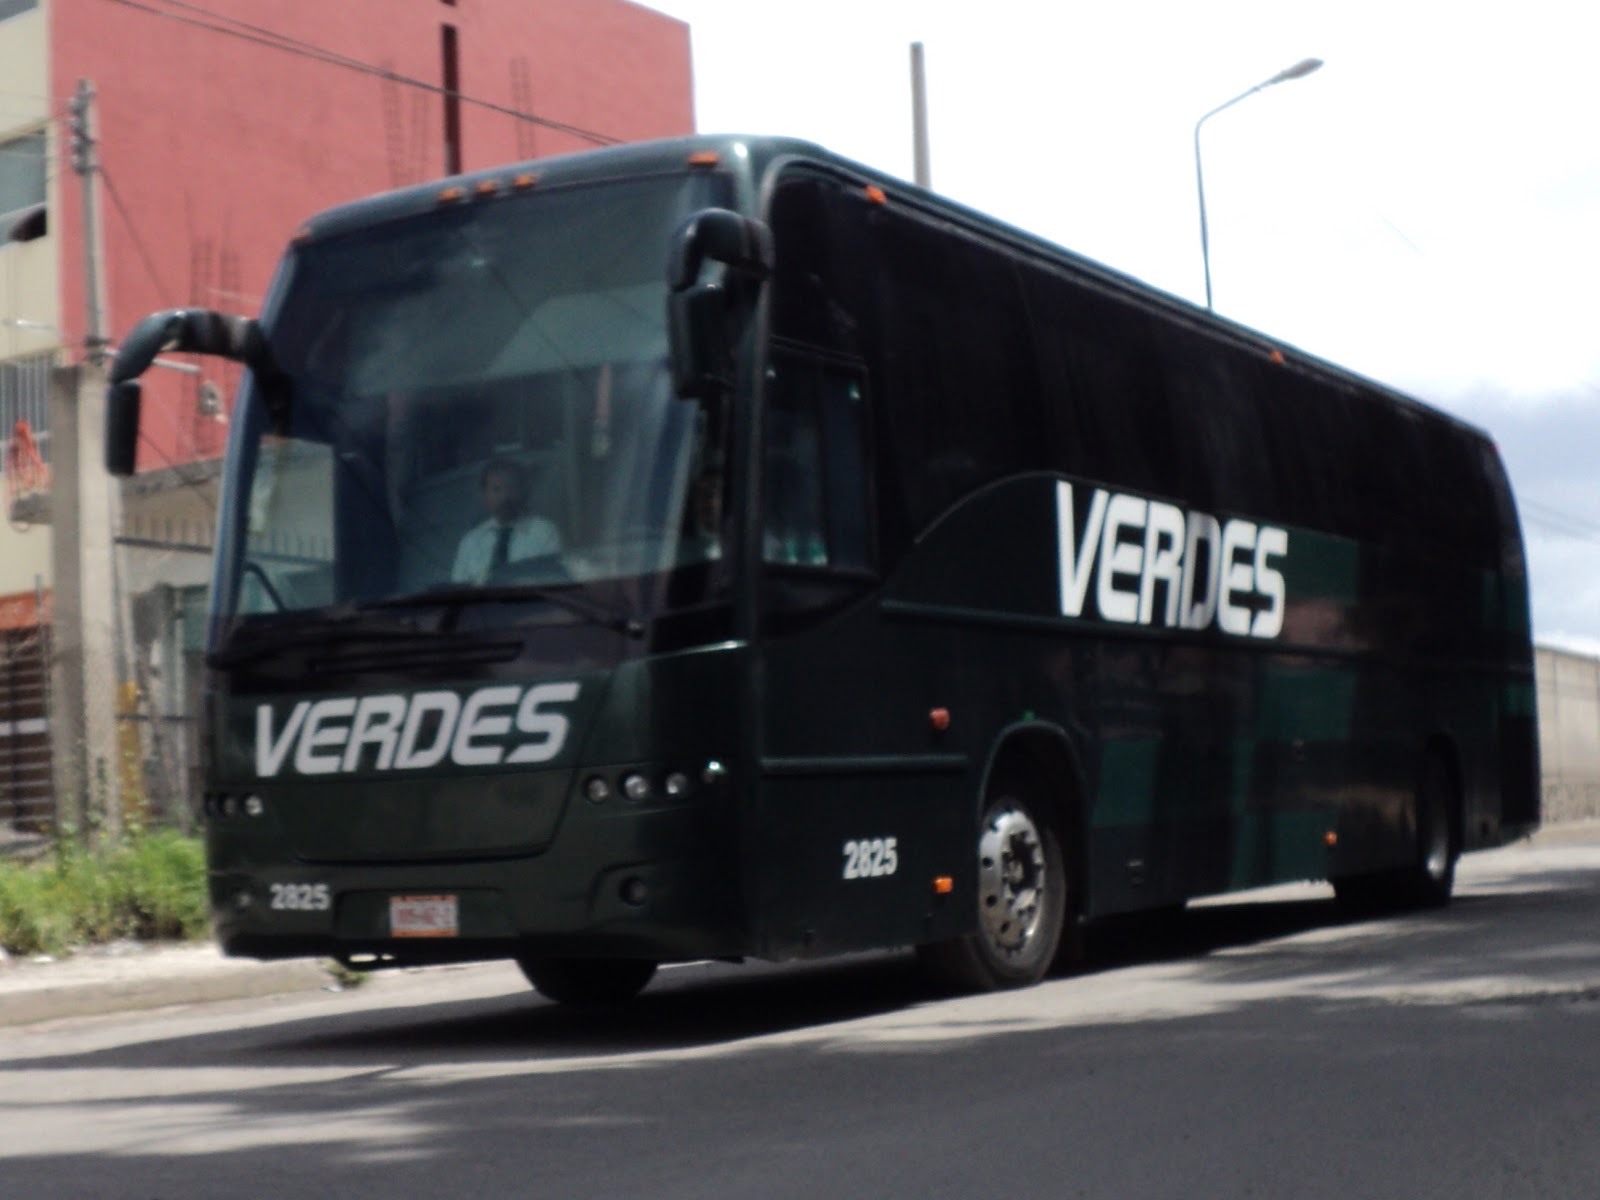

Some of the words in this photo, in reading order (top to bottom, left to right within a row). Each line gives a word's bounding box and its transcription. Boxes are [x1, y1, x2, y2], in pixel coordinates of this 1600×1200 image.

[1056, 479, 1288, 639] VERDES
[255, 682, 580, 778] VERDES
[842, 836, 898, 879] 2825
[270, 882, 331, 910] 2825
